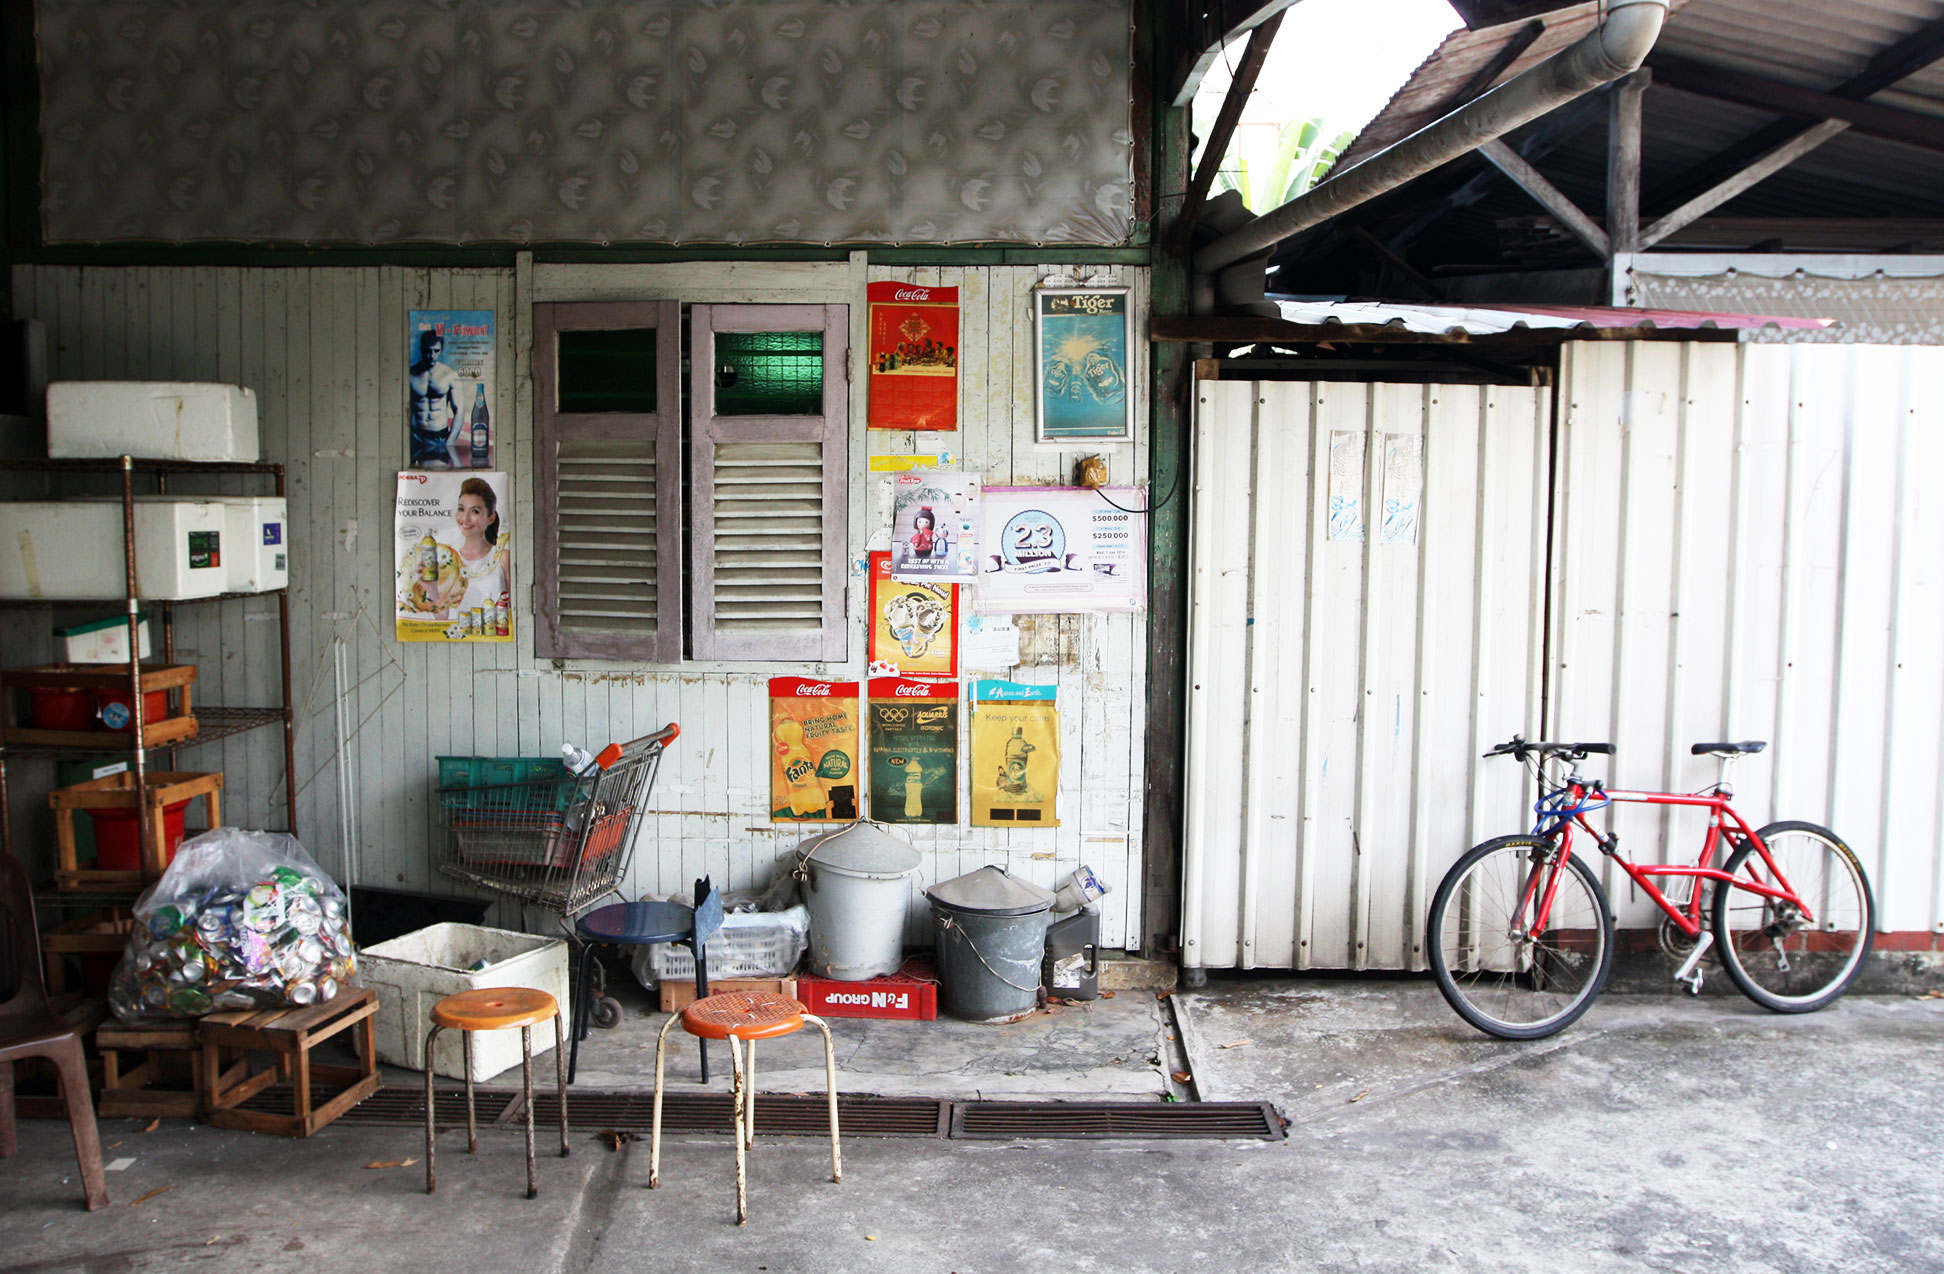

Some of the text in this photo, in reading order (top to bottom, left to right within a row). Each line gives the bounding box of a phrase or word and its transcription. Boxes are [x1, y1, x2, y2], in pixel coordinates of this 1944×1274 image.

[1072, 296, 1114, 314] Tiger
[1088, 362, 1110, 377] Tiger
[1015, 550, 1051, 558] MILLION
[803, 713, 848, 727] BRING HOME
[985, 714, 1007, 723] Keep
[1009, 715, 1027, 723] your
[804, 722, 837, 733] NATURAL
[806, 730, 829, 739] FRUITY
[823, 758, 849, 769] NATURAL
[825, 992, 909, 1009] F&N GROUP
